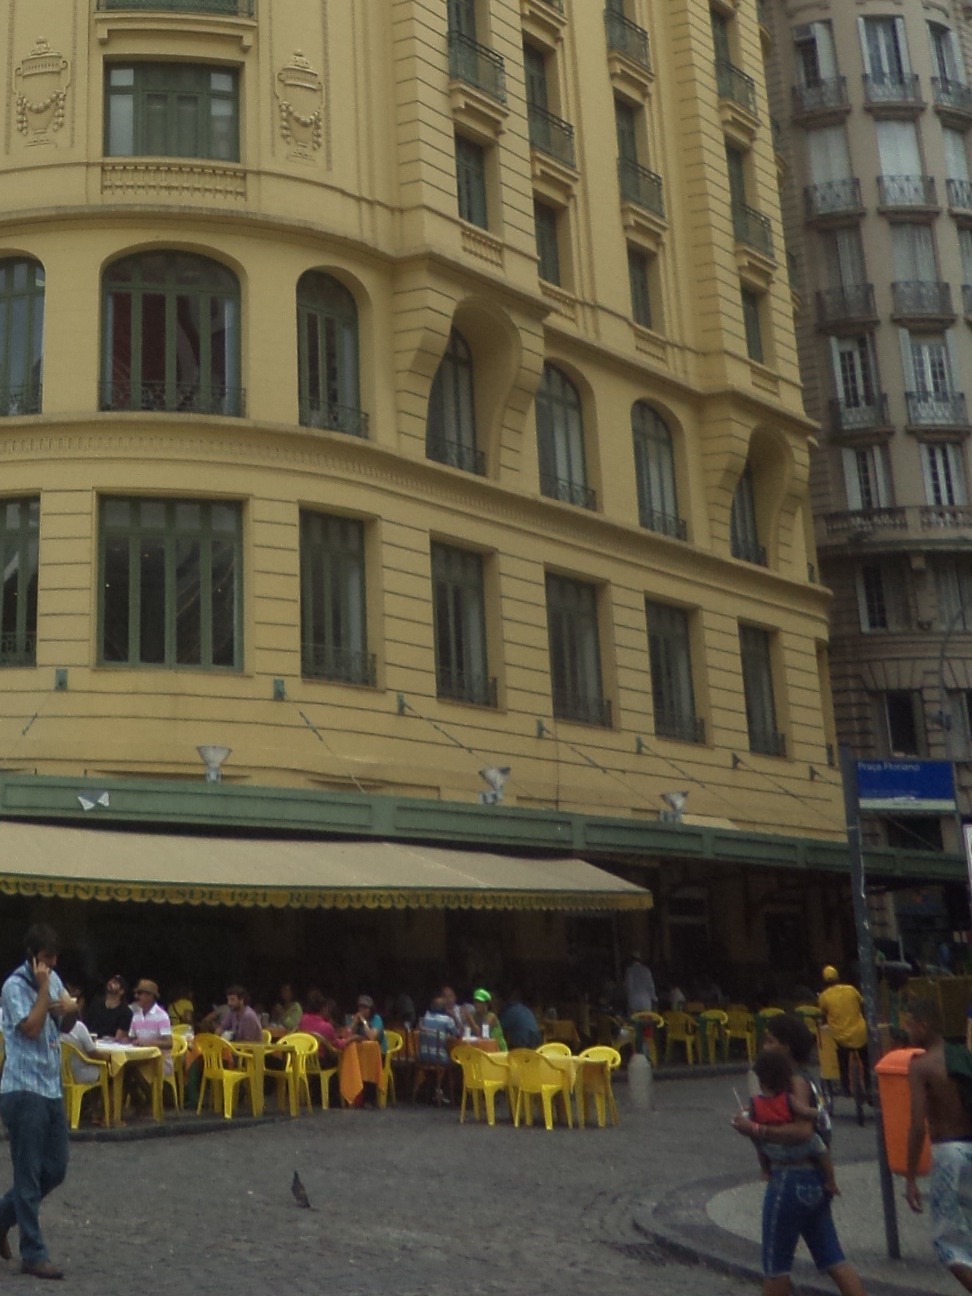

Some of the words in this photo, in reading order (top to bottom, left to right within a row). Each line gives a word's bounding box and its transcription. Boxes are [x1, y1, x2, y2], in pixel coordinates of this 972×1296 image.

[857, 762, 882, 772] Praça
[884, 762, 920, 771] Floriano
[140, 887, 221, 901] DESDE
[229, 890, 269, 902] 1921
[289, 892, 434, 904] RESTAURANTE
[441, 894, 474, 904] BAR
